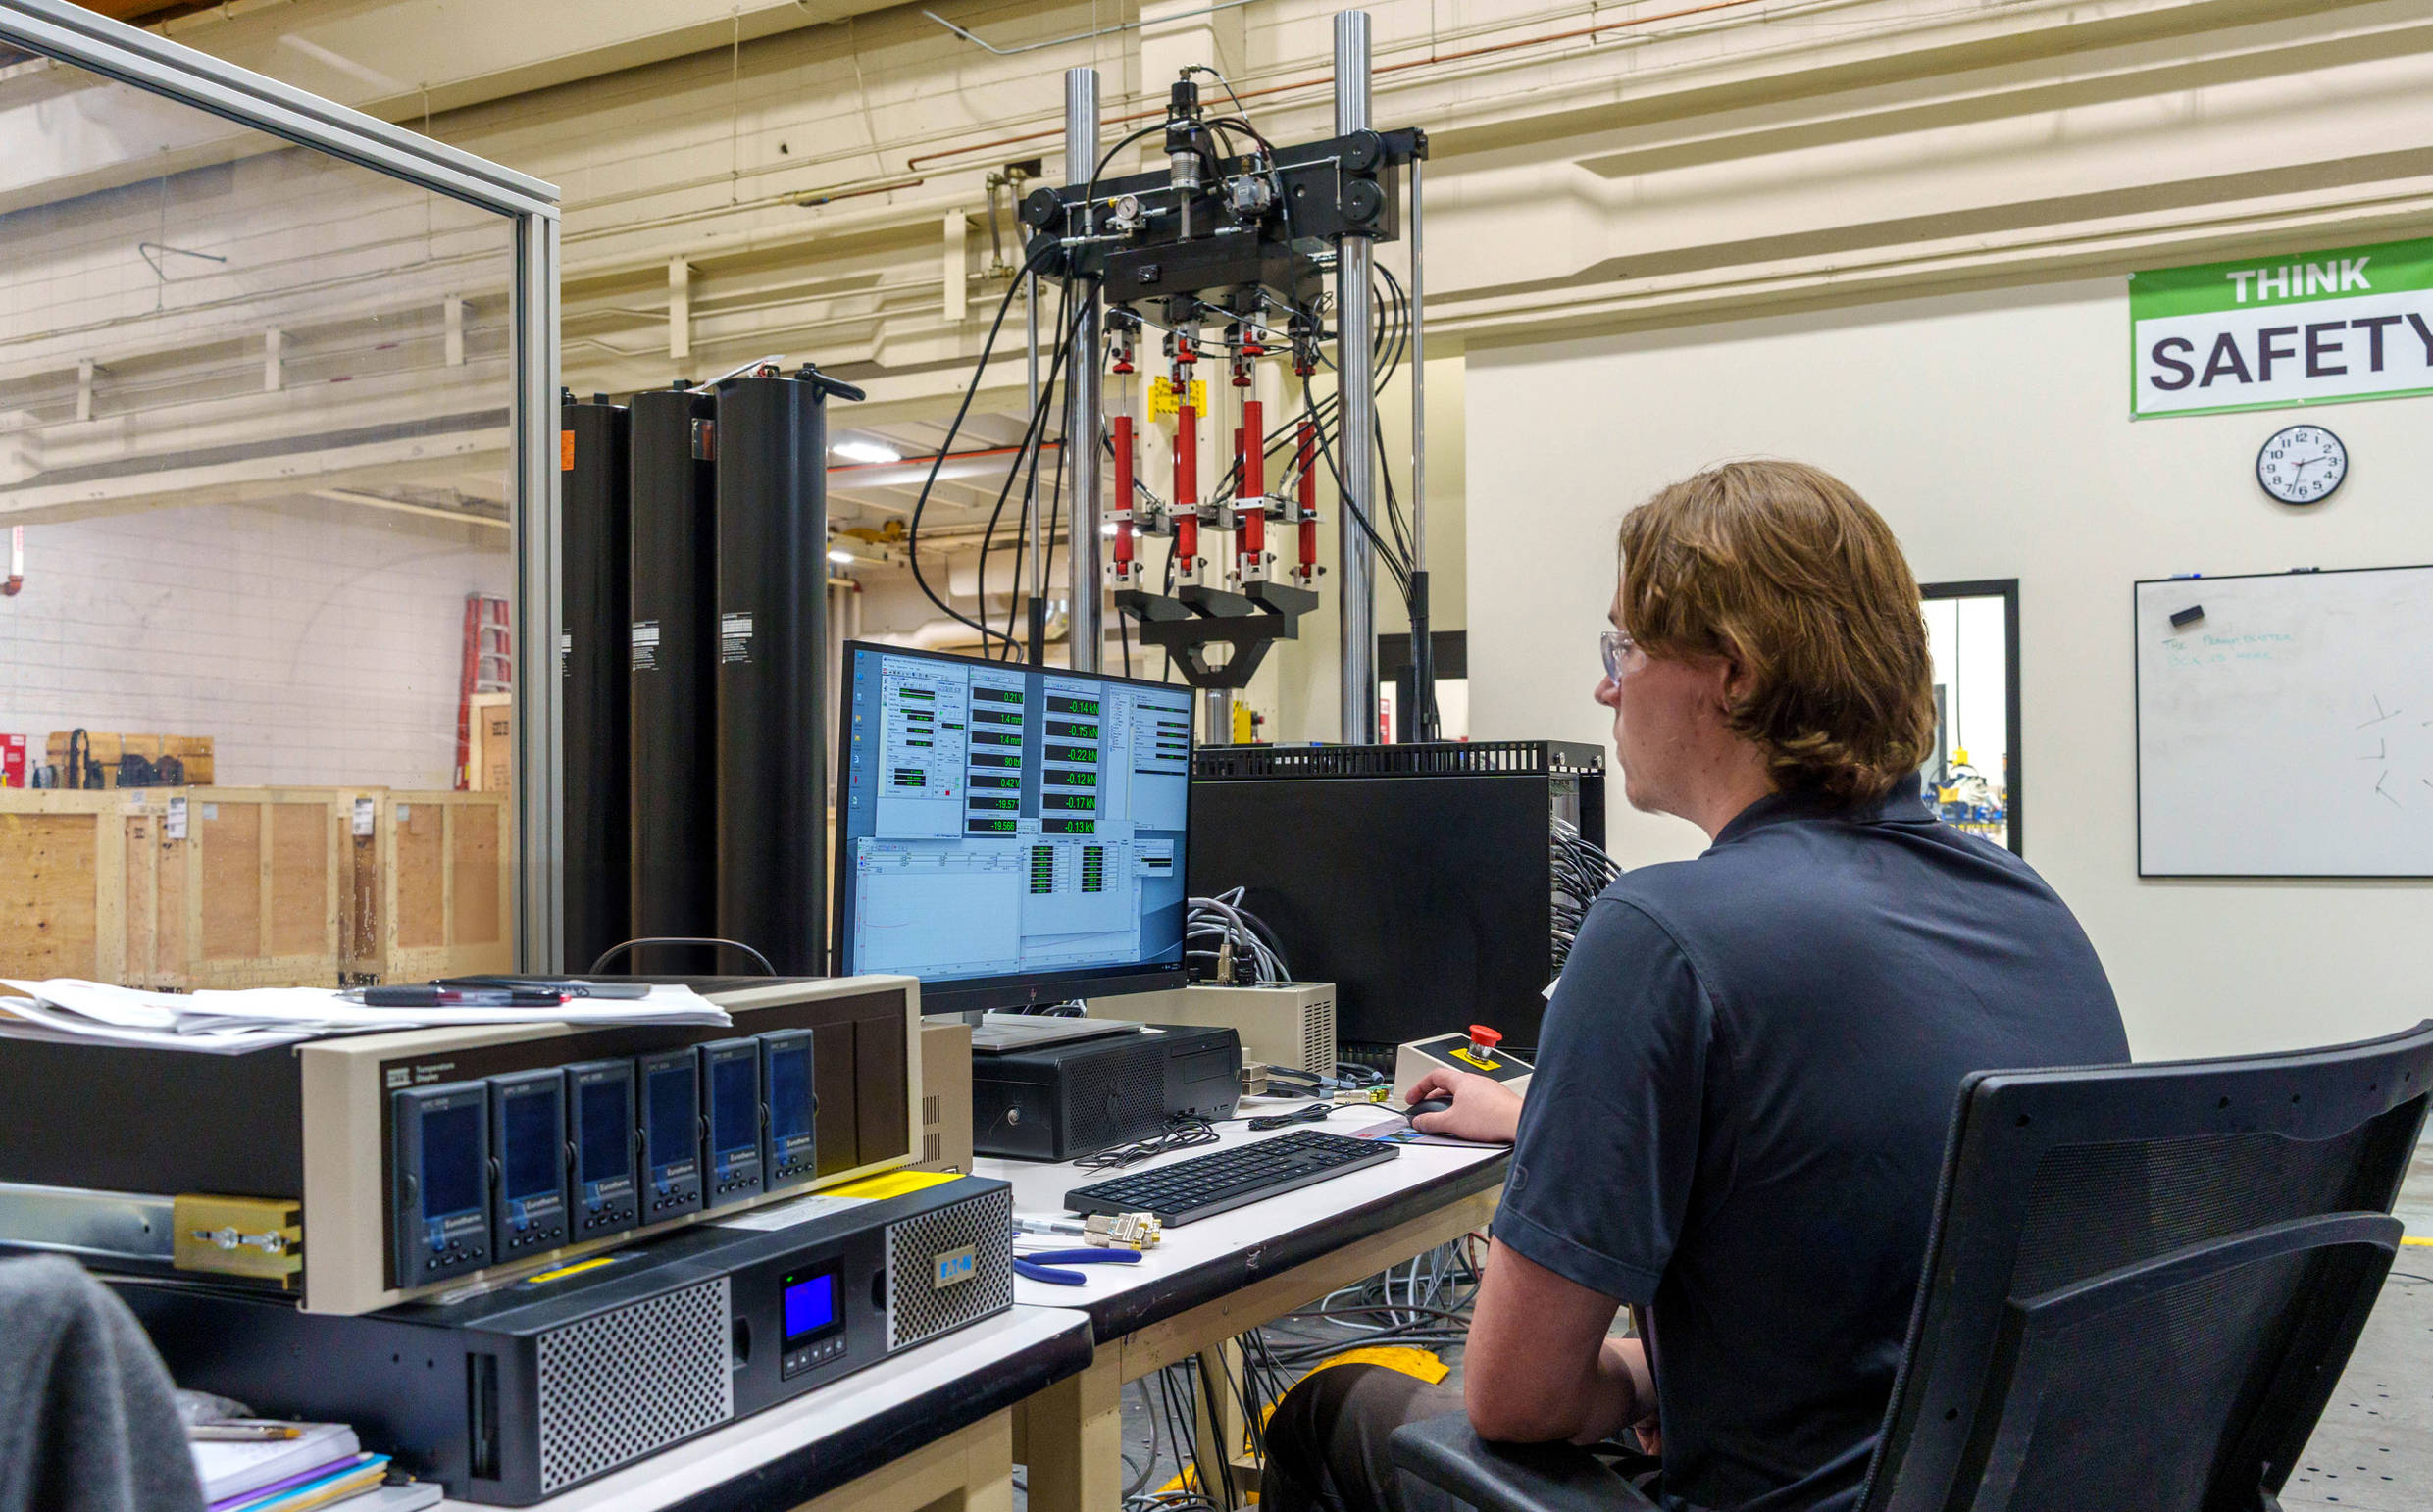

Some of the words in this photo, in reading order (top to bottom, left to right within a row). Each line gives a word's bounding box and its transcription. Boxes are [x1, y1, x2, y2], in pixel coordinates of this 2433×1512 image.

[2226, 257, 2371, 303] THINK
[2295, 433, 2307, 443] 12
[2282, 439, 2291, 448] 11
[2323, 444, 2332, 454] 2
[2270, 450, 2284, 460] 10
[2328, 457, 2338, 467] 3
[2266, 464, 2276, 474] 9
[2323, 471, 2333, 479] 4
[2272, 476, 2282, 485] 8
[2313, 480, 2322, 490] 5
[2284, 484, 2293, 493] 7
[2299, 486, 2307, 496] 6
[1003, 692, 1017, 702] 0.21
[1069, 700, 1089, 714] -0.14
[1090, 702, 1098, 715] kN
[1001, 713, 1010, 723] 1.4
[1068, 725, 1088, 737] -0.15
[1089, 726, 1098, 738] kN
[1000, 735, 1009, 745] 1.4
[1067, 748, 1087, 761] -0.22
[1088, 750, 1097, 762] kN
[1004, 757, 1013, 766] 90
[1000, 778, 1015, 787] 0.42
[1067, 773, 1086, 784] -0.12
[1087, 774, 1096, 785] kN
[995, 799, 1016, 809] -19.57
[1066, 796, 1085, 809] -0.17
[1086, 797, 1095, 809] kN
[1065, 821, 1084, 832] -0.13
[1085, 821, 1094, 832] kN
